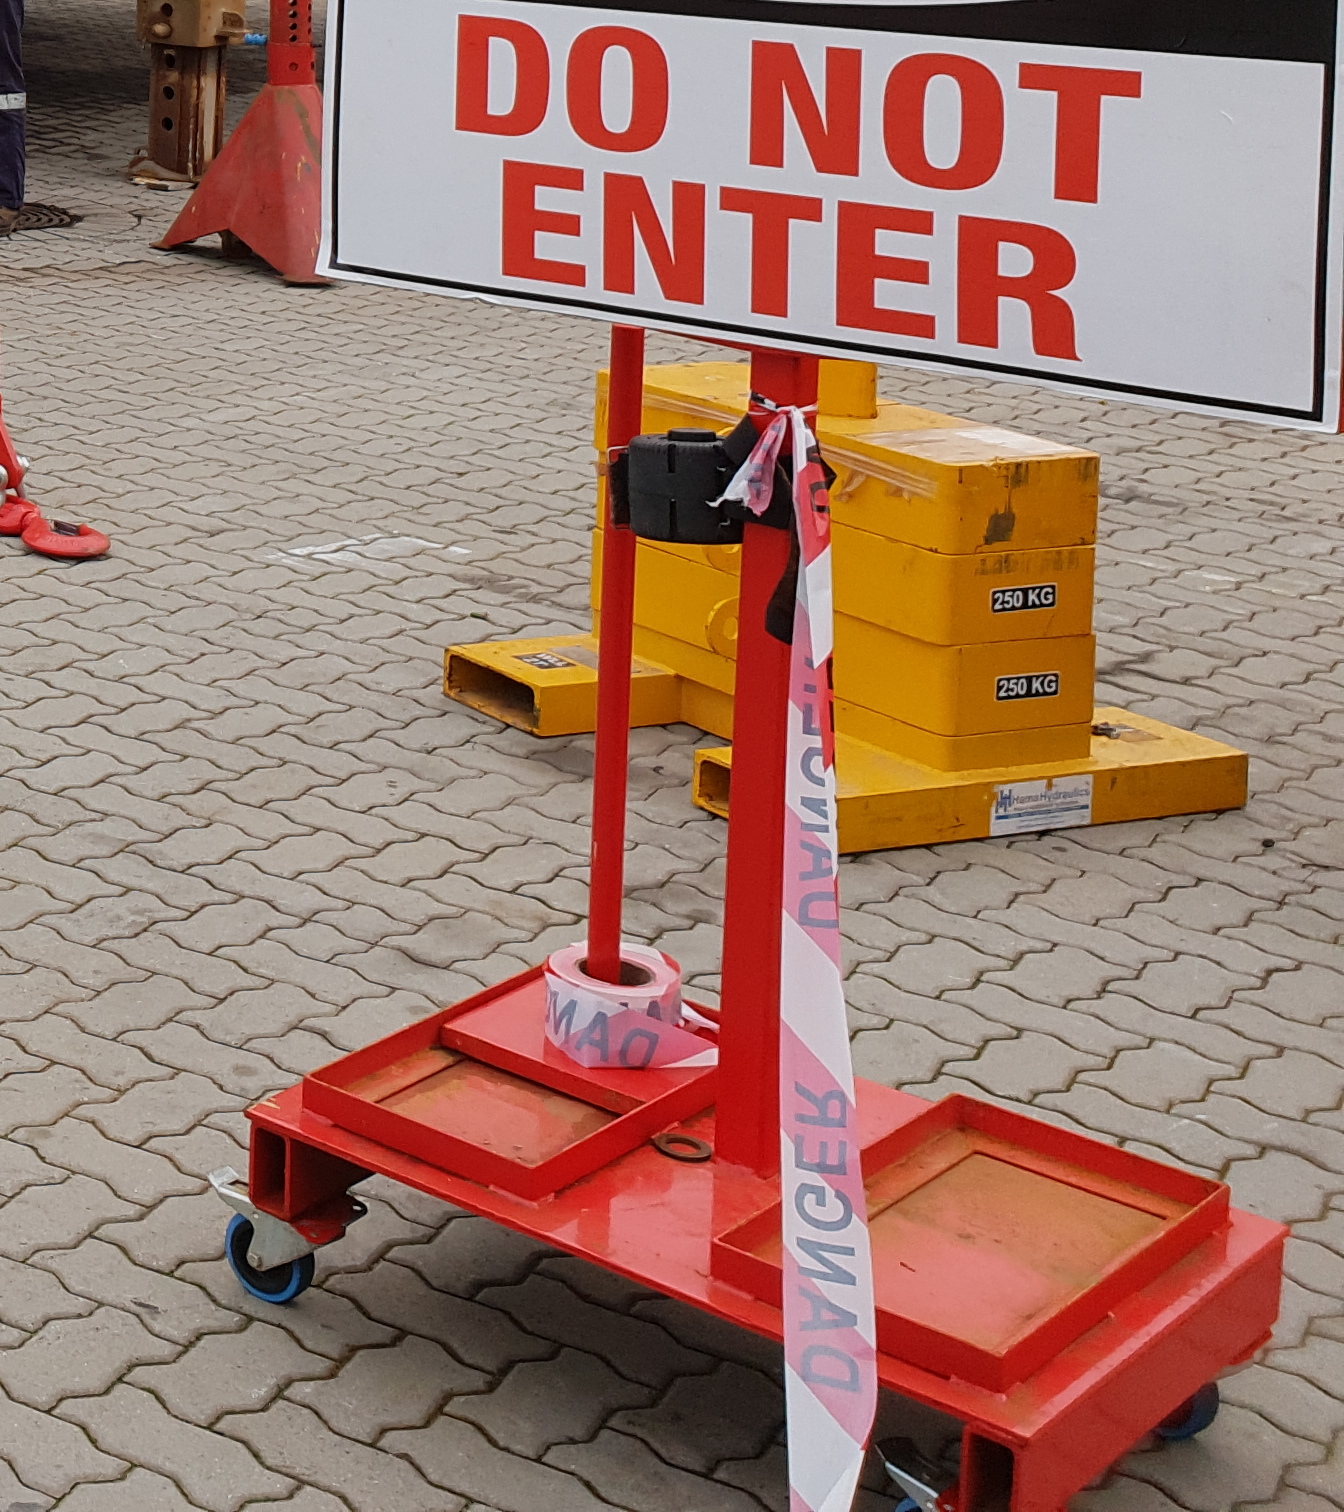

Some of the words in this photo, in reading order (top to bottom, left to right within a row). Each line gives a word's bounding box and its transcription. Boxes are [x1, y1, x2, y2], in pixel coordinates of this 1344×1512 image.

[454, 13, 670, 154] DO
[748, 39, 1144, 205] NOT
[500, 158, 1086, 363] ENTER
[993, 589, 1023, 610] 250
[1028, 587, 1054, 606] KG
[998, 678, 1027, 698] 250
[1032, 675, 1057, 694] KG
